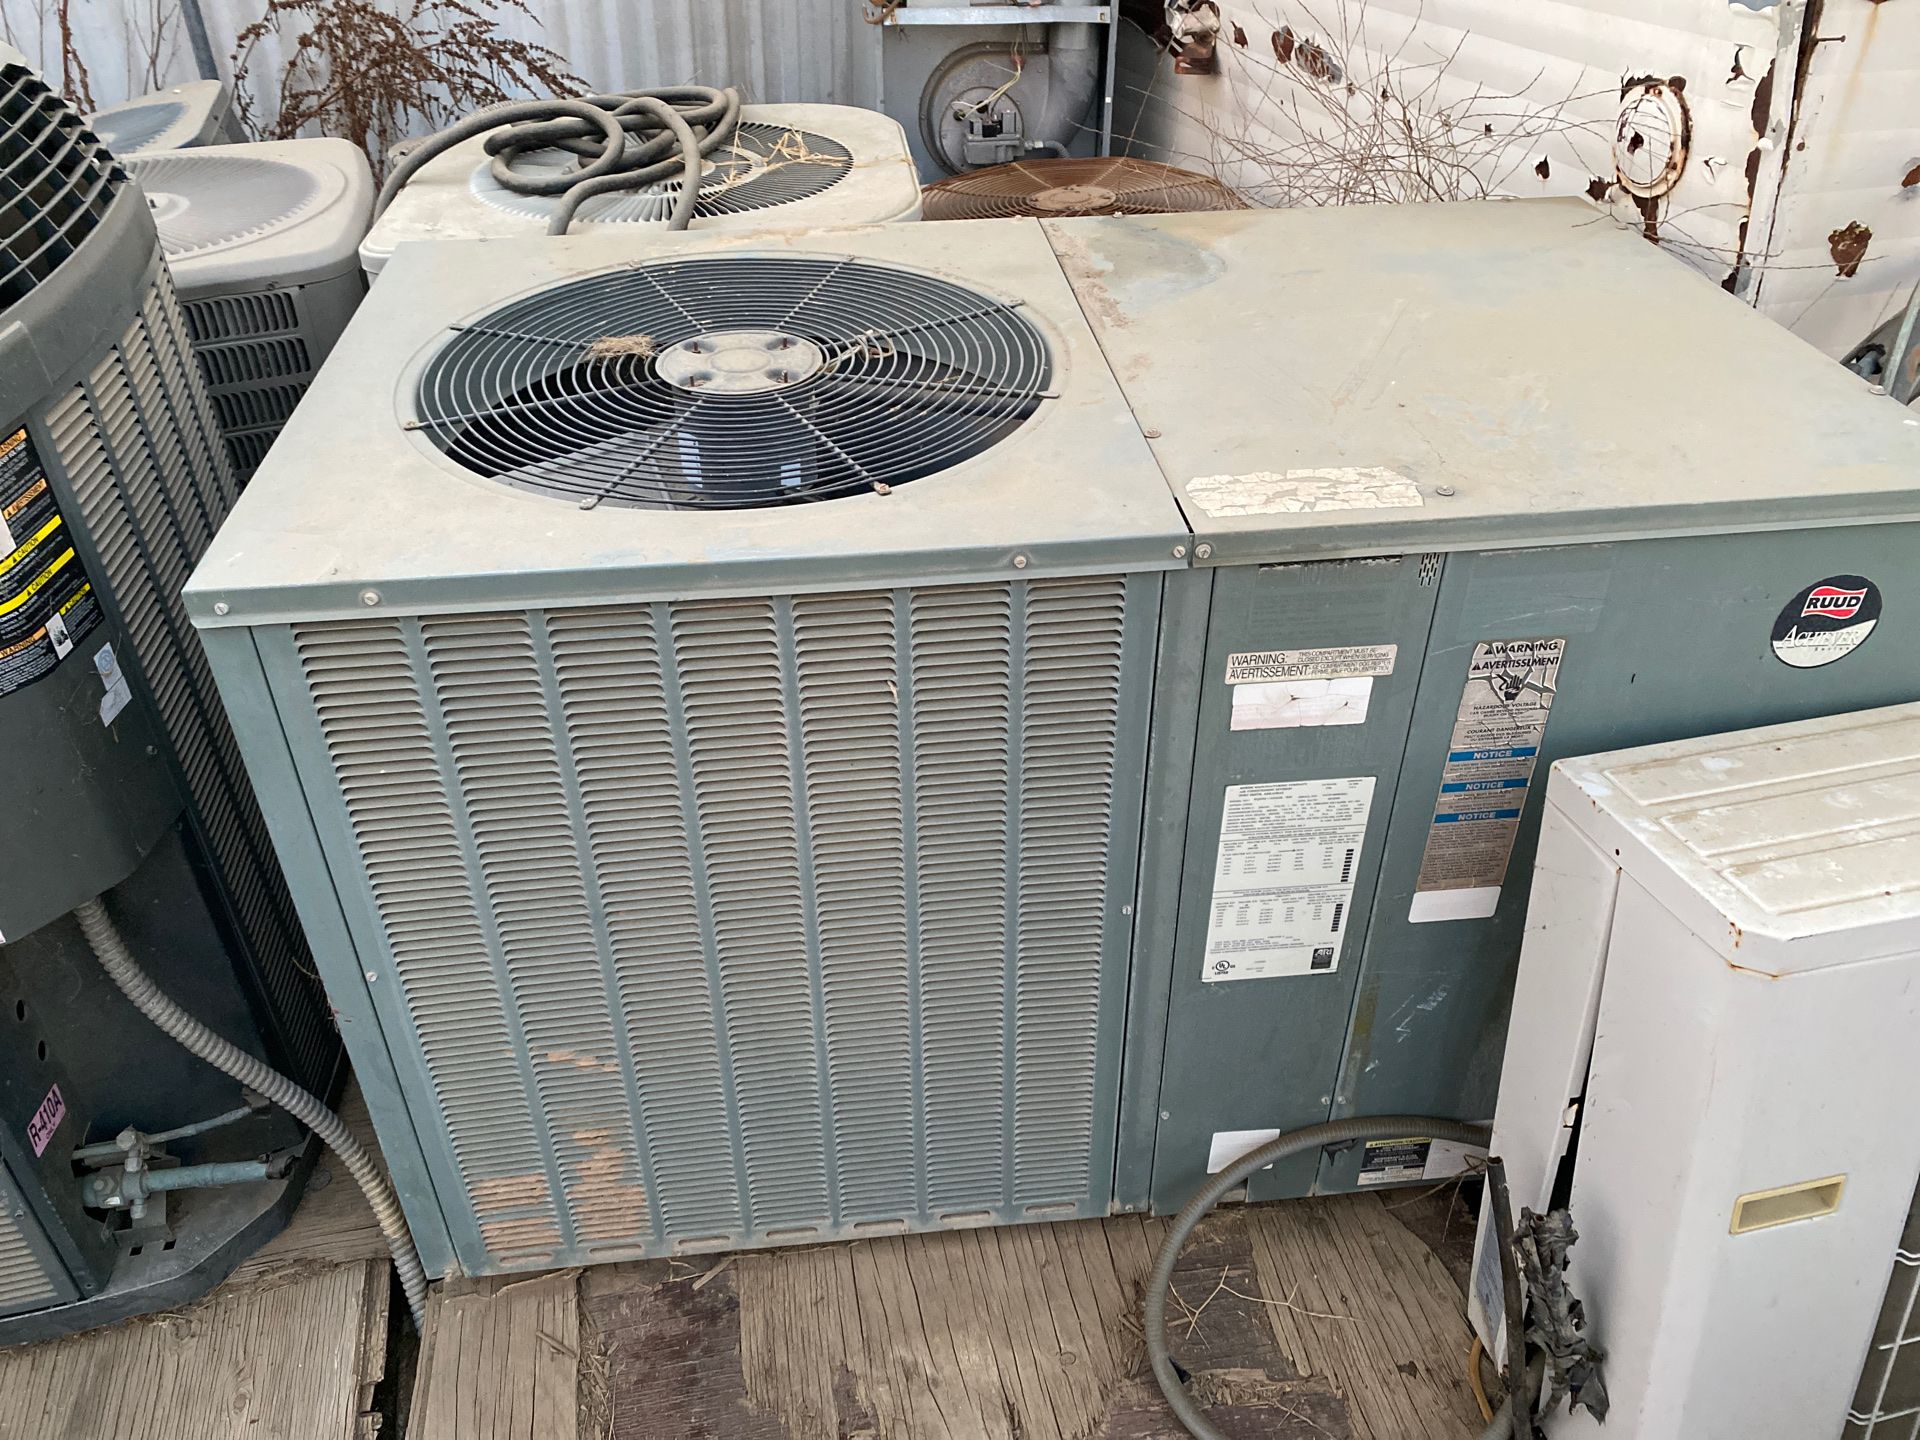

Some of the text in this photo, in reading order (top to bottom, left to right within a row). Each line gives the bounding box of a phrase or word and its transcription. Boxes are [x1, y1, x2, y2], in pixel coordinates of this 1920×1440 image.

[17, 536, 39, 558] CAUTION
[31, 568, 53, 590] CAUTION
[1806, 596, 1861, 609] RUUD
[1496, 642, 1558, 654] WARNING
[1473, 750, 1513, 759] NOTICE
[1466, 781, 1505, 790] NOTICE
[1458, 812, 1496, 821] NOTICE
[29, 1089, 62, 1147] R-410A
